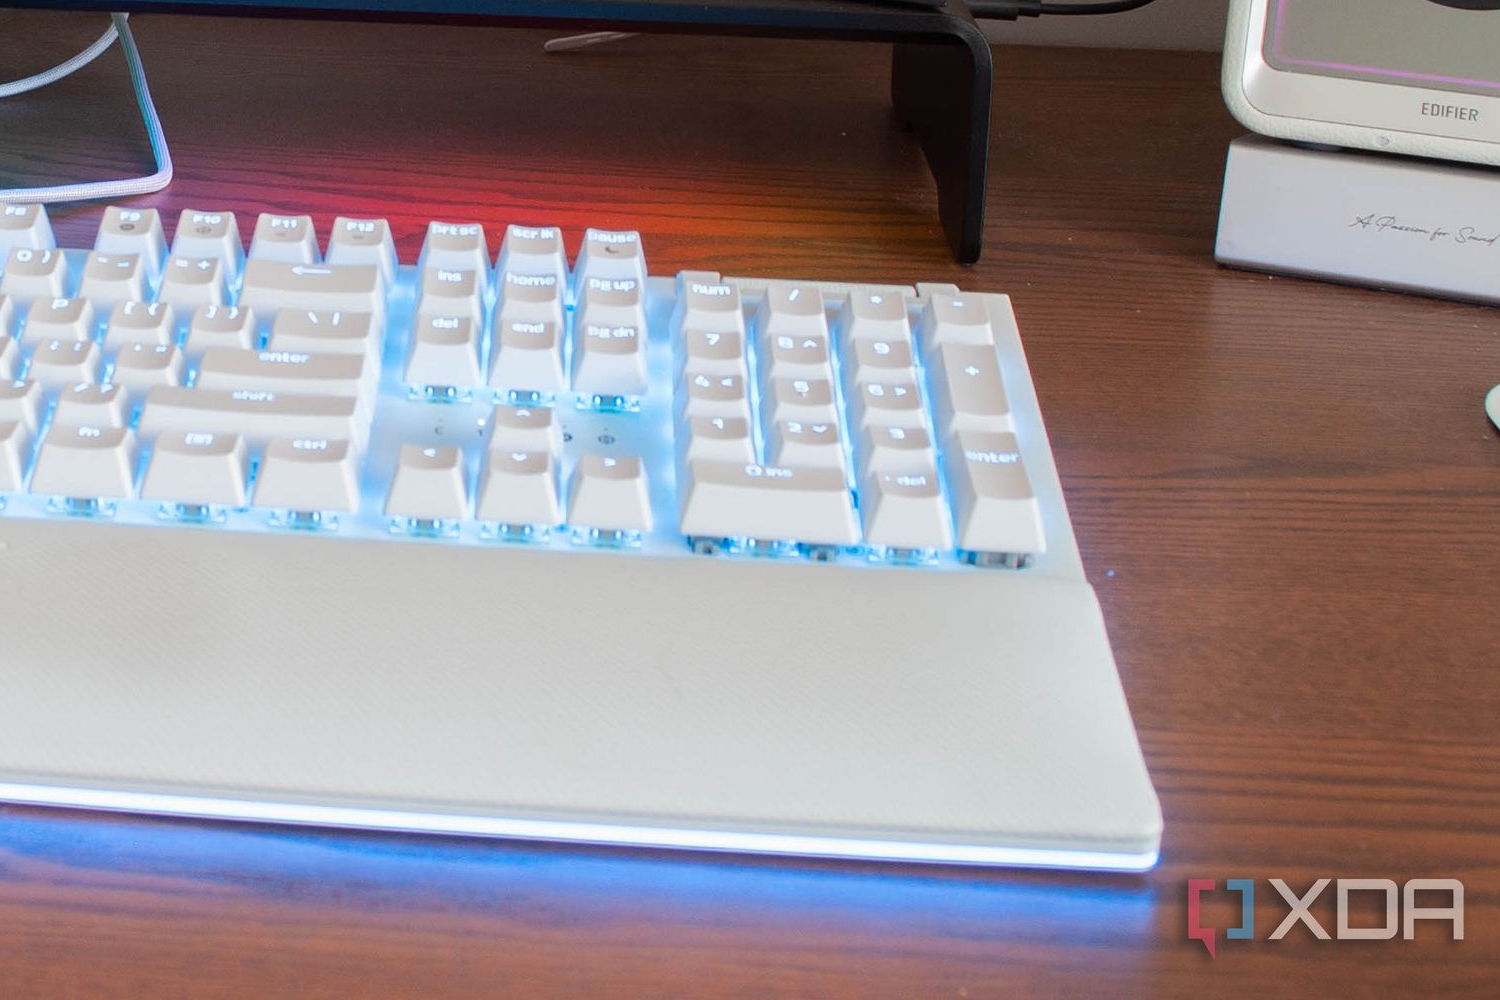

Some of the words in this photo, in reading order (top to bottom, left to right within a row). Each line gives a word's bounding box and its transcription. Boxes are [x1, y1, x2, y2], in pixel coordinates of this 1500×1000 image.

[1421, 102, 1479, 121] EDIFIER
[6, 206, 26, 216] F8
[120, 212, 141, 221] F9
[192, 214, 221, 224] F10
[271, 218, 297, 228] F11
[347, 222, 374, 232] F12
[588, 231, 637, 244] pause
[438, 271, 462, 282] ins
[507, 273, 555, 286] home
[693, 284, 731, 295] num
[432, 318, 459, 329] del
[512, 322, 544, 333] end
[259, 352, 309, 363] enter
